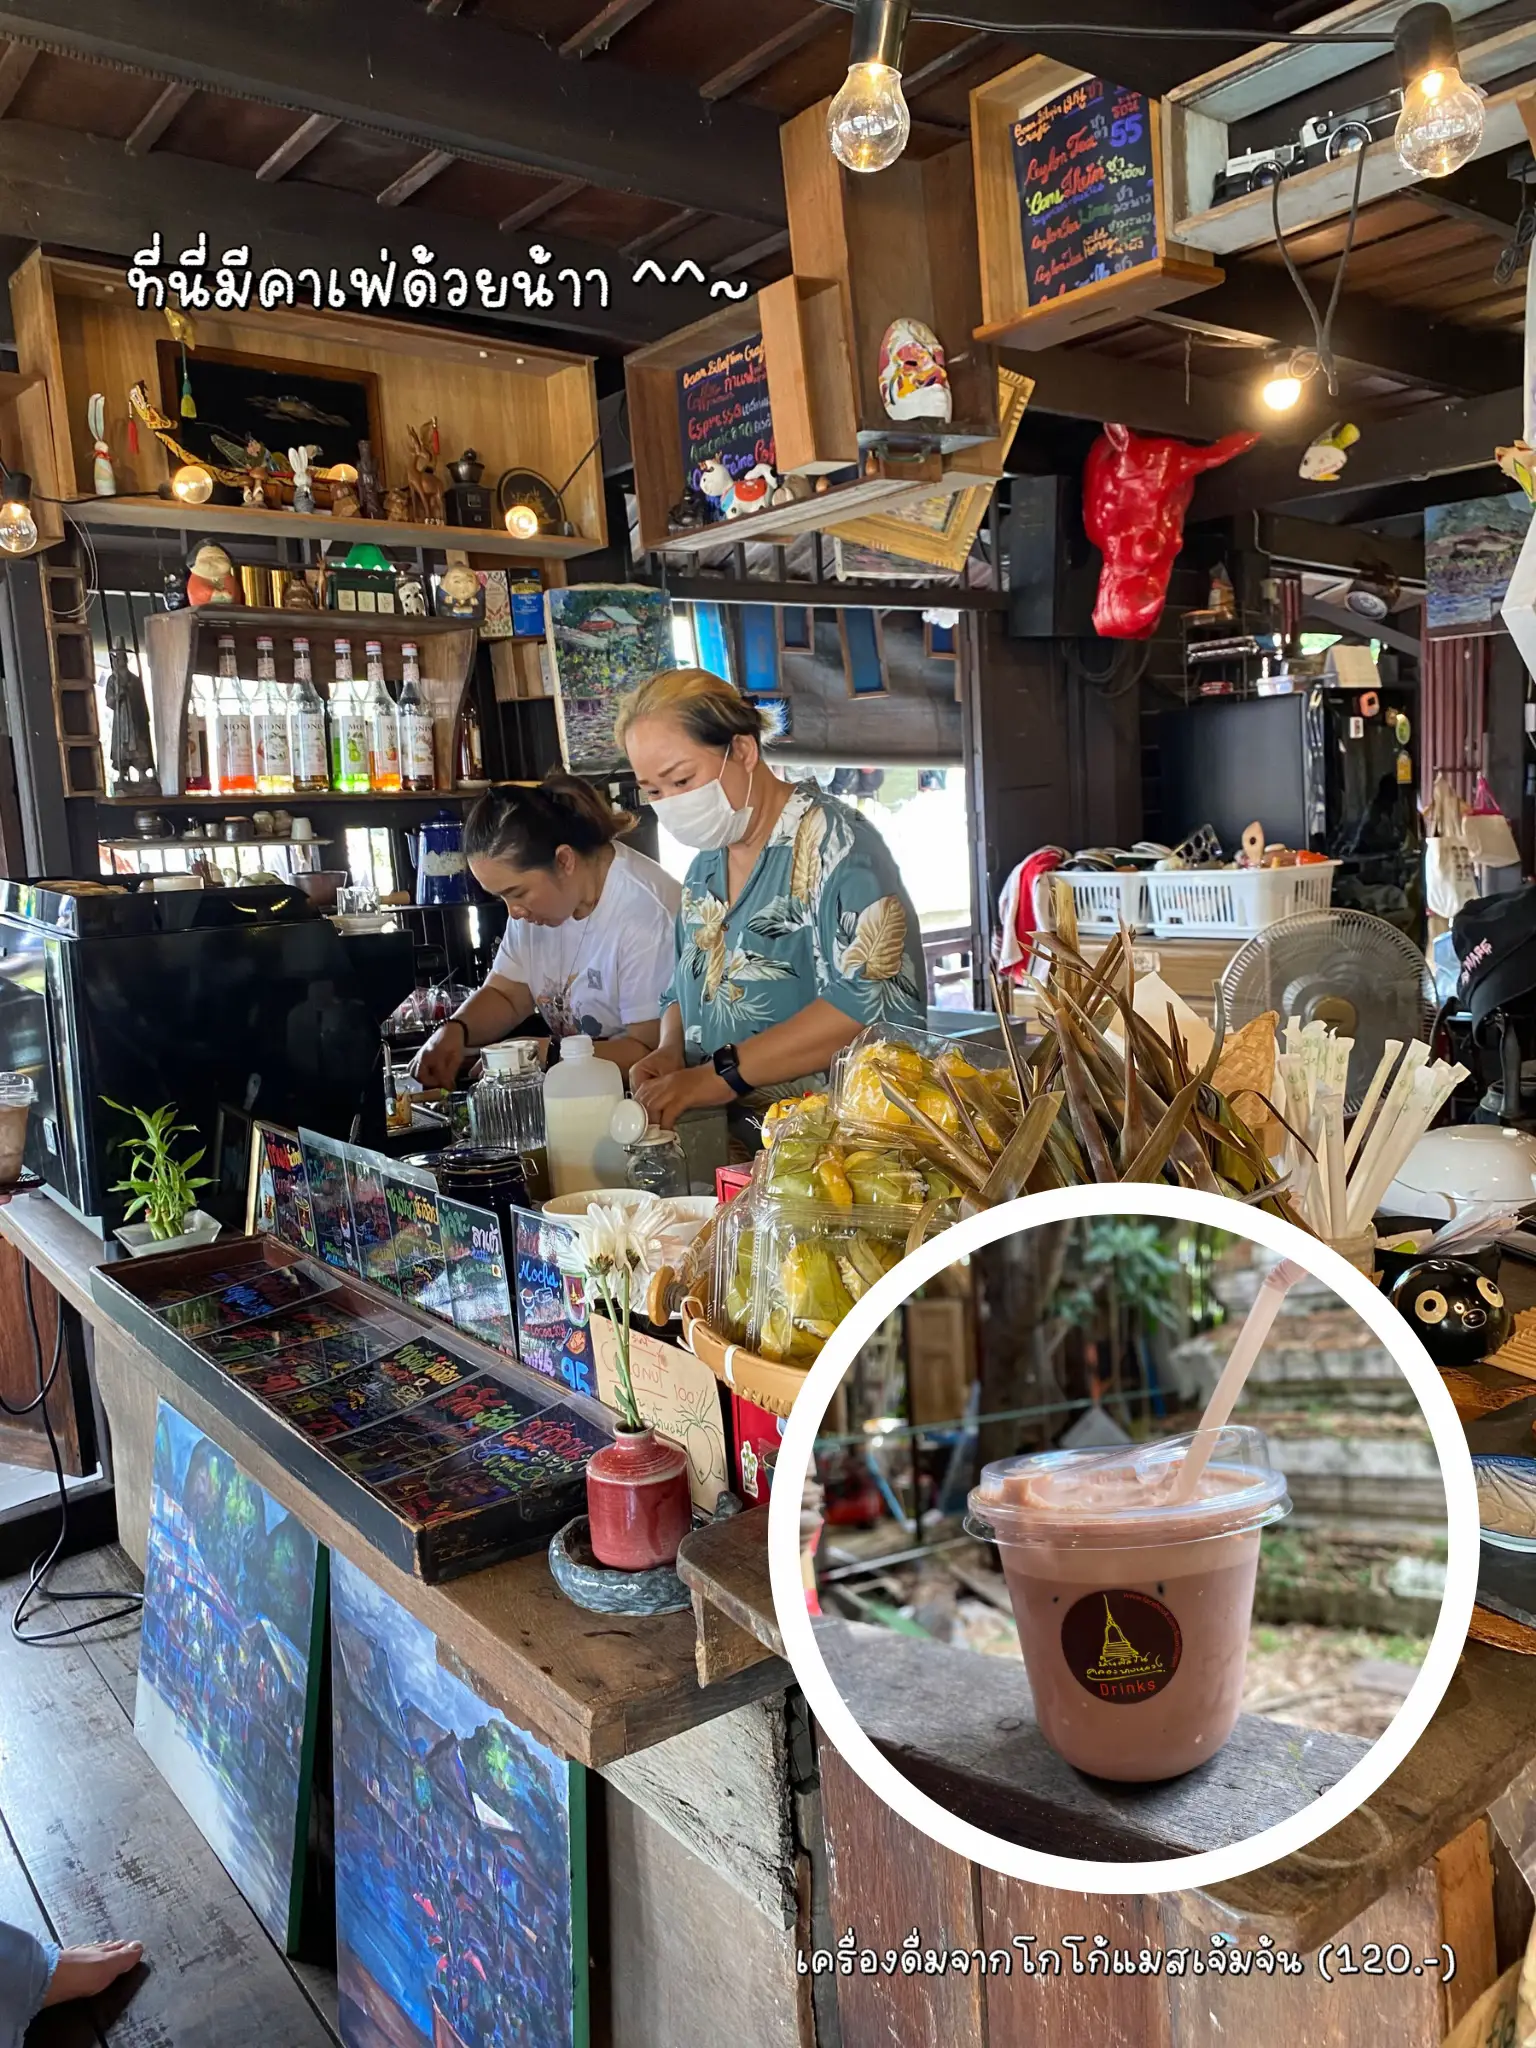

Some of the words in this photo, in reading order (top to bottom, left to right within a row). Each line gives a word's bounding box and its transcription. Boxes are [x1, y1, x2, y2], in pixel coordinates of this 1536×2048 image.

[1109, 113, 1143, 148] 55
[518, 1260, 560, 1289] Mocha
[560, 1356, 591, 1396] 95
[1099, 1679, 1156, 1696] Drinks
